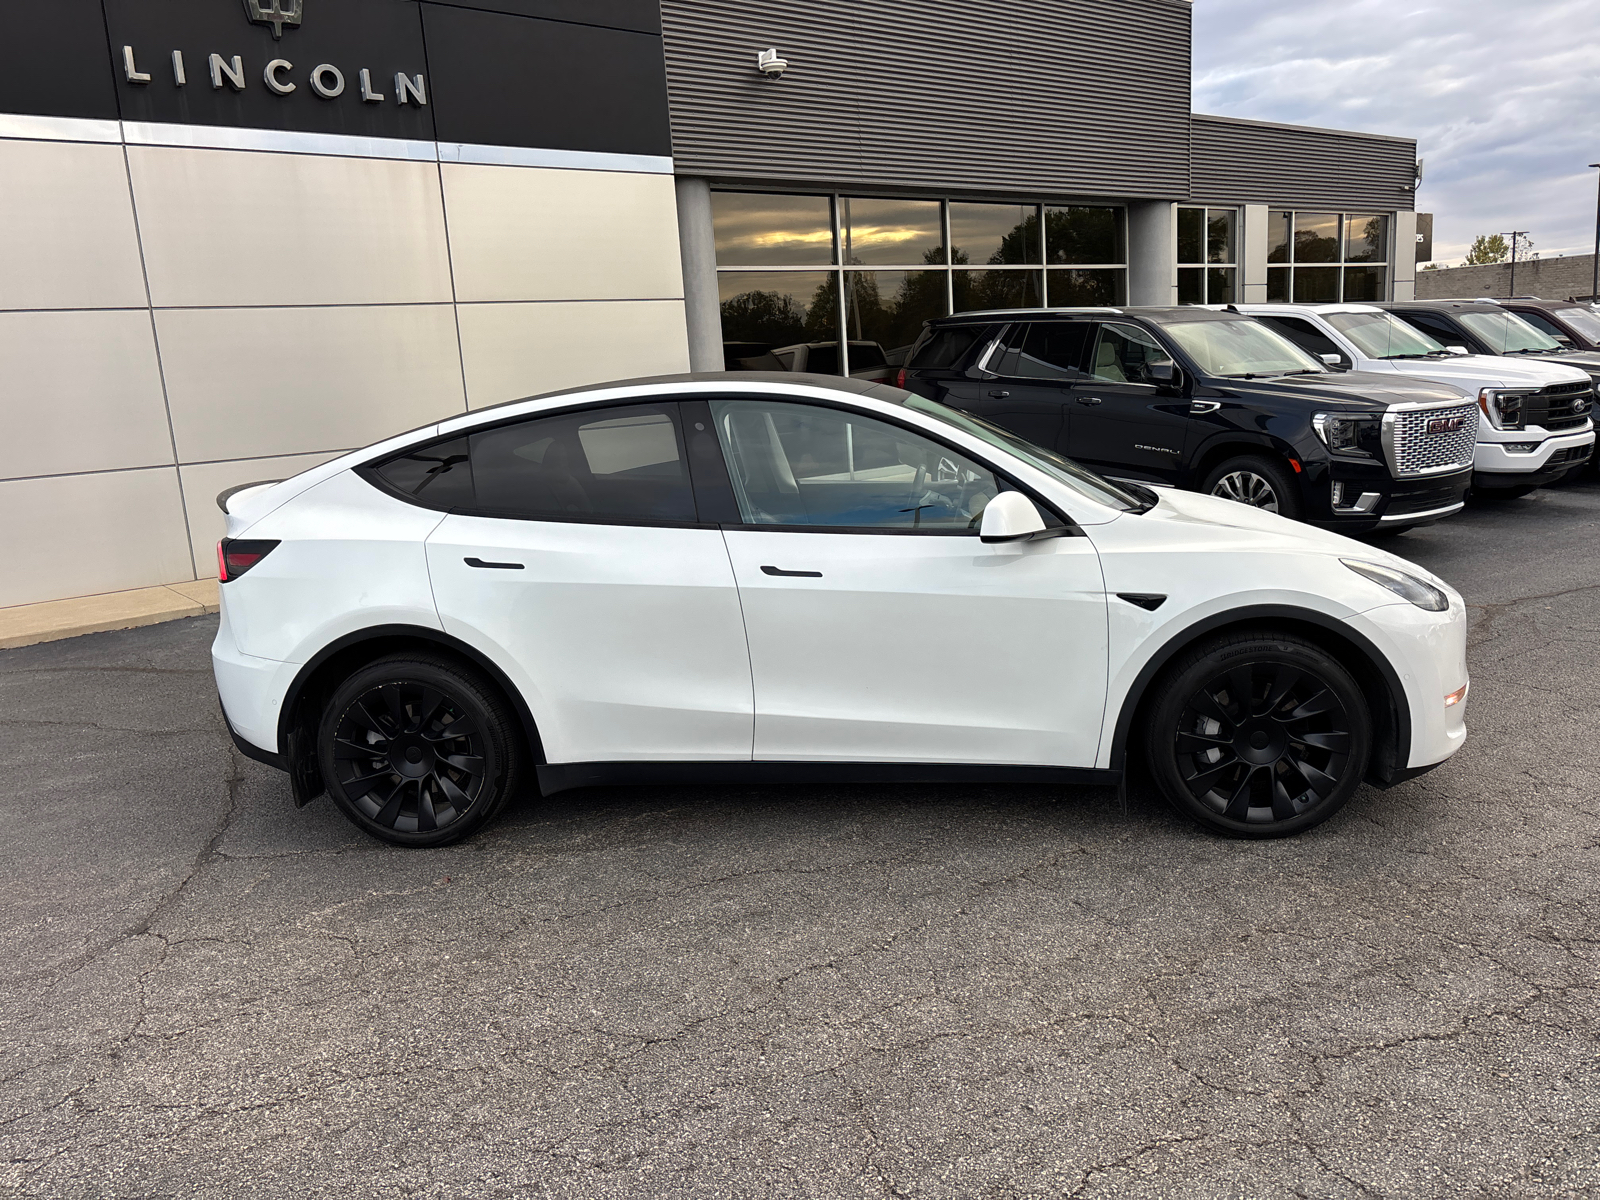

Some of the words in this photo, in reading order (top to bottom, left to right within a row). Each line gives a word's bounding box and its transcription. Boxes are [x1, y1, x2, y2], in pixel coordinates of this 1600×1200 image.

[121, 45, 427, 106] LINCOLN
[1428, 416, 1465, 434] GMC
[1134, 443, 1181, 455] DENALI
[1220, 645, 1273, 661] BRIDGESTONE
